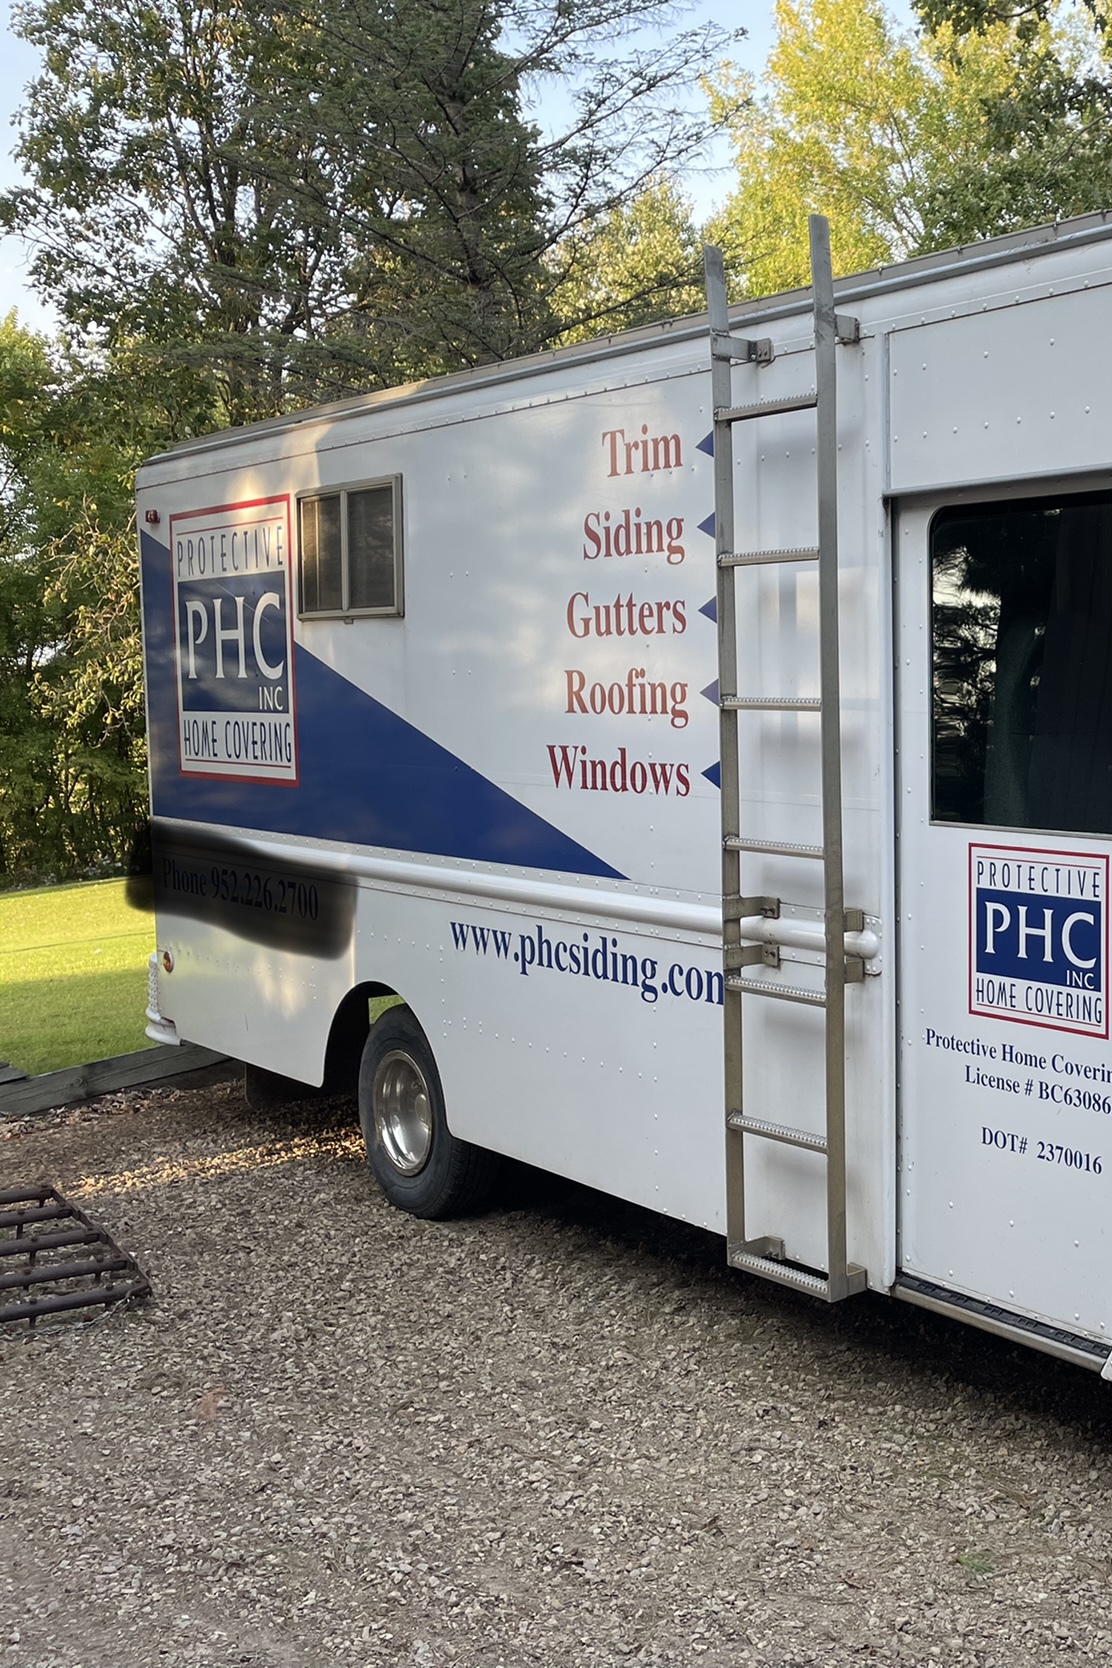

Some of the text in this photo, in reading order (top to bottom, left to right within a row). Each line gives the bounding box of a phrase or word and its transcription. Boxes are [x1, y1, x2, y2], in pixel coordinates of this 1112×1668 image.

[601, 423, 684, 478] Trim
[177, 525, 284, 577] PROTECTIVE
[582, 507, 686, 566] Siding
[185, 592, 285, 681] PHC
[566, 592, 687, 639] Gutters
[259, 686, 284, 712] INC
[564, 667, 690, 729] Roofing
[183, 719, 293, 764] HOME COVERING
[546, 744, 691, 797] Windows
[161, 857, 319, 921] Phone 952.226.2700
[976, 860, 1101, 899] PROTECTIVE
[984, 901, 1097, 969] PHC
[976, 977, 1103, 1025] HOME COVERING
[1066, 969, 1096, 990] INC
[925, 1028, 998, 1060] Protective
[1001, 1043, 1047, 1070] Home
[965, 1064, 1020, 1095] License
[1024, 1078, 1034, 1097] #
[981, 1126, 1103, 1175] DOT# 2370016
